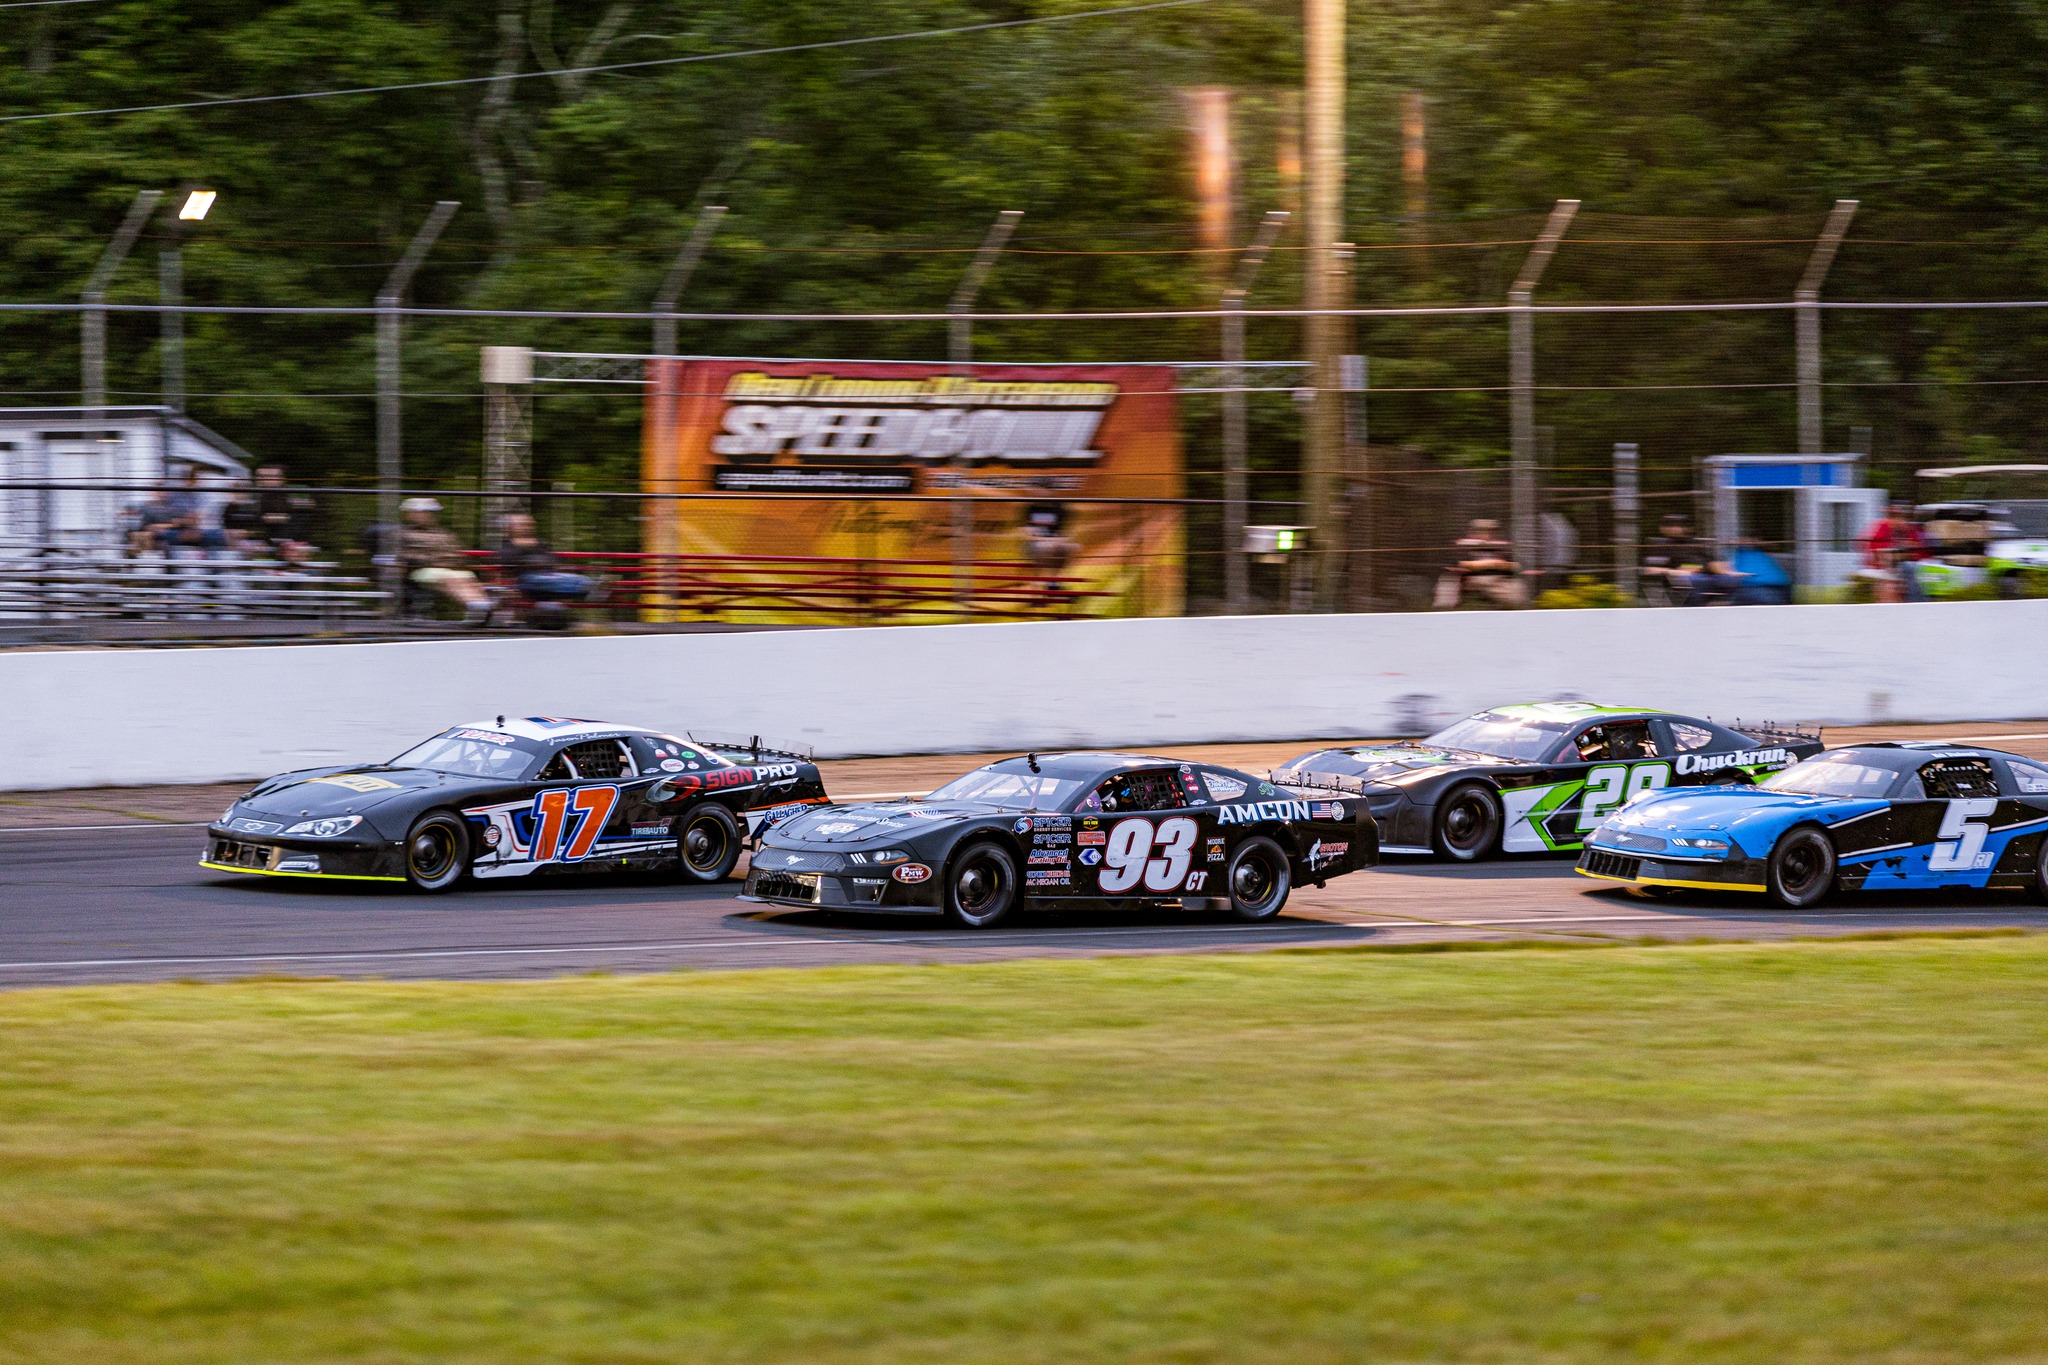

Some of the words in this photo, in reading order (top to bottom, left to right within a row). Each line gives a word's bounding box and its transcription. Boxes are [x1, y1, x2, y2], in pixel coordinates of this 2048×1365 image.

[1675, 748, 1787, 776] Chuckran
[705, 769, 753, 790] SIGN
[754, 763, 797, 781] PRO
[528, 783, 621, 863] 17
[1033, 817, 1072, 827] SPICER
[1217, 801, 1312, 826] AMCON
[1033, 833, 1072, 844] SPICER
[1928, 798, 1998, 871] 5
[1030, 848, 1069, 857] Advanced
[1098, 816, 1200, 894] 93
[1207, 853, 1225, 862] PIZZA
[900, 867, 924, 878] PMW
[1060, 877, 1071, 885] OIL
[1185, 871, 1208, 892] CT
